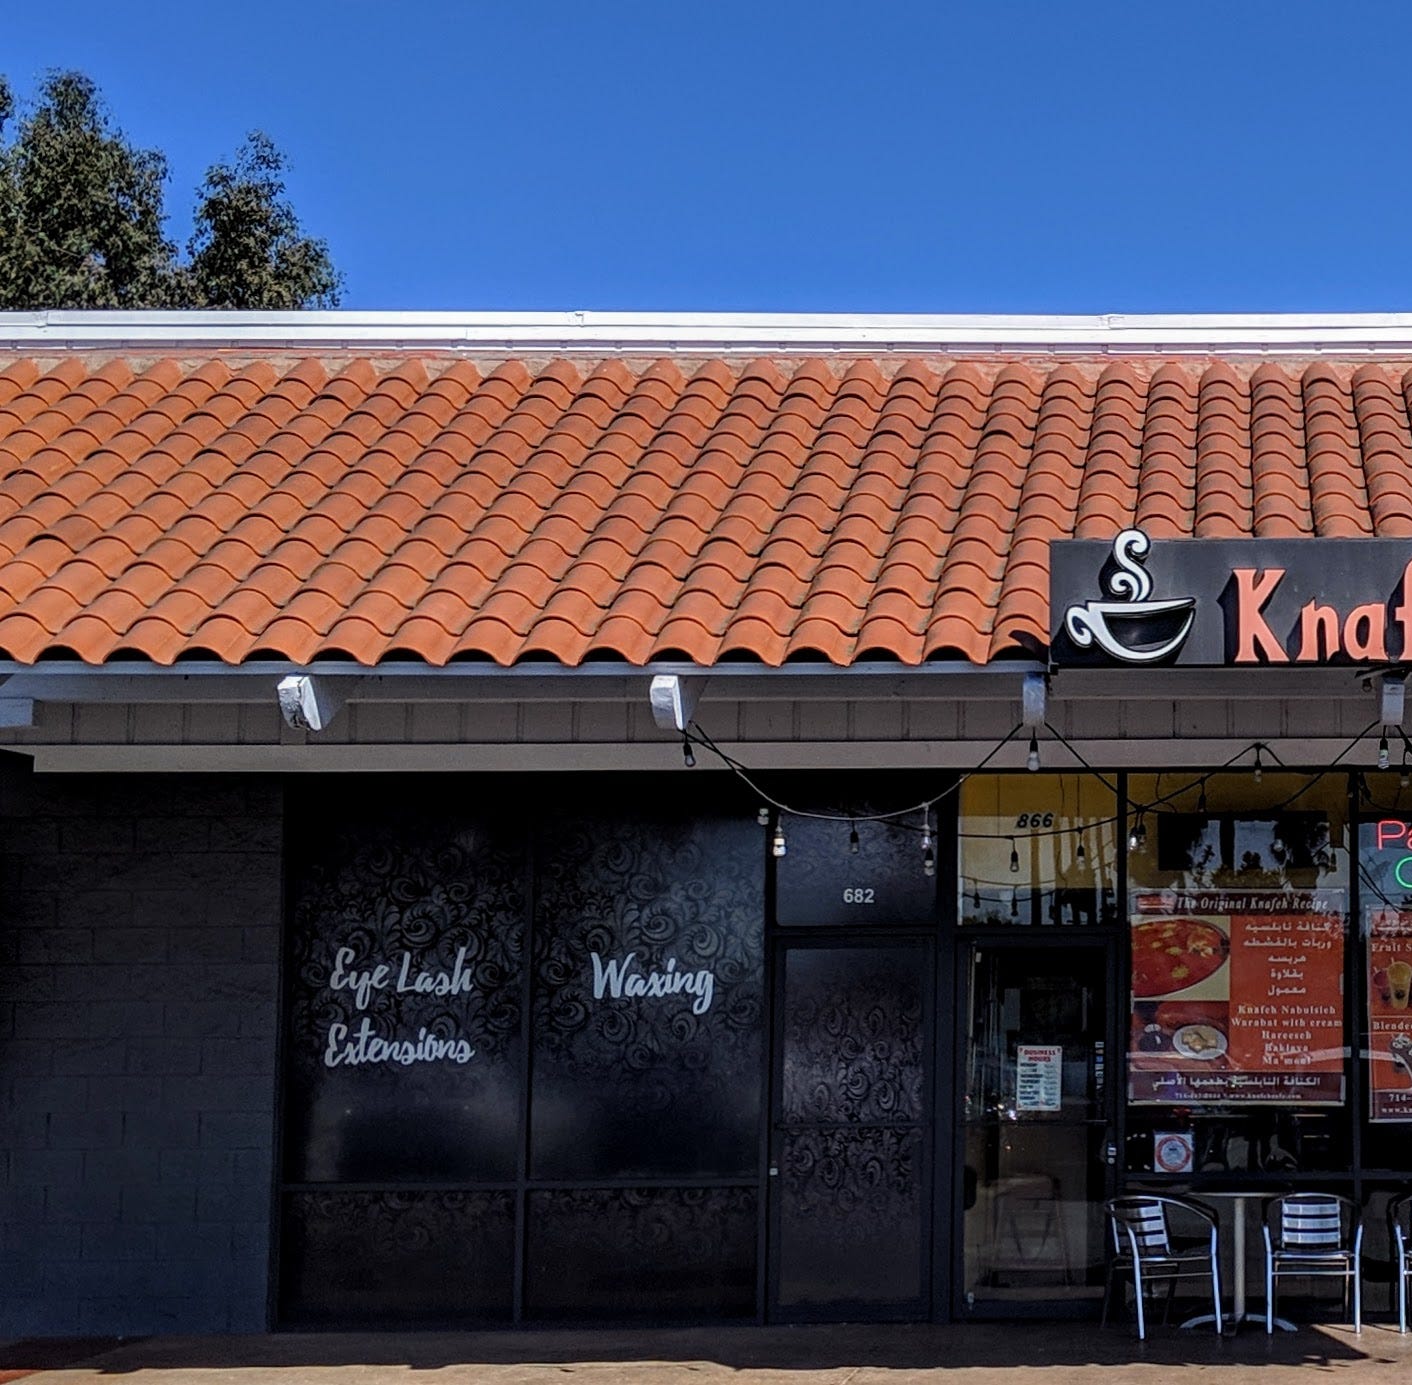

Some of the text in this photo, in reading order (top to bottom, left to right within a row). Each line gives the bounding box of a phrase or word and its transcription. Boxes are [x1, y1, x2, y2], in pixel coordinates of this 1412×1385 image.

[1016, 812, 1054, 829] 866
[843, 888, 874, 903] 682
[1177, 897, 1197, 909] The
[1201, 896, 1246, 912] Original
[1250, 896, 1288, 911] Knafeh
[1292, 897, 1328, 911] Recipe
[1371, 943, 1400, 953] Fruit
[329, 947, 474, 1009] Eye Lash
[590, 952, 714, 1015] Waxing
[1238, 1005, 1277, 1015] Knafeh
[1282, 1018, 1306, 1027] with
[1310, 1019, 1343, 1027] cream
[324, 1018, 475, 1068] Extensions
